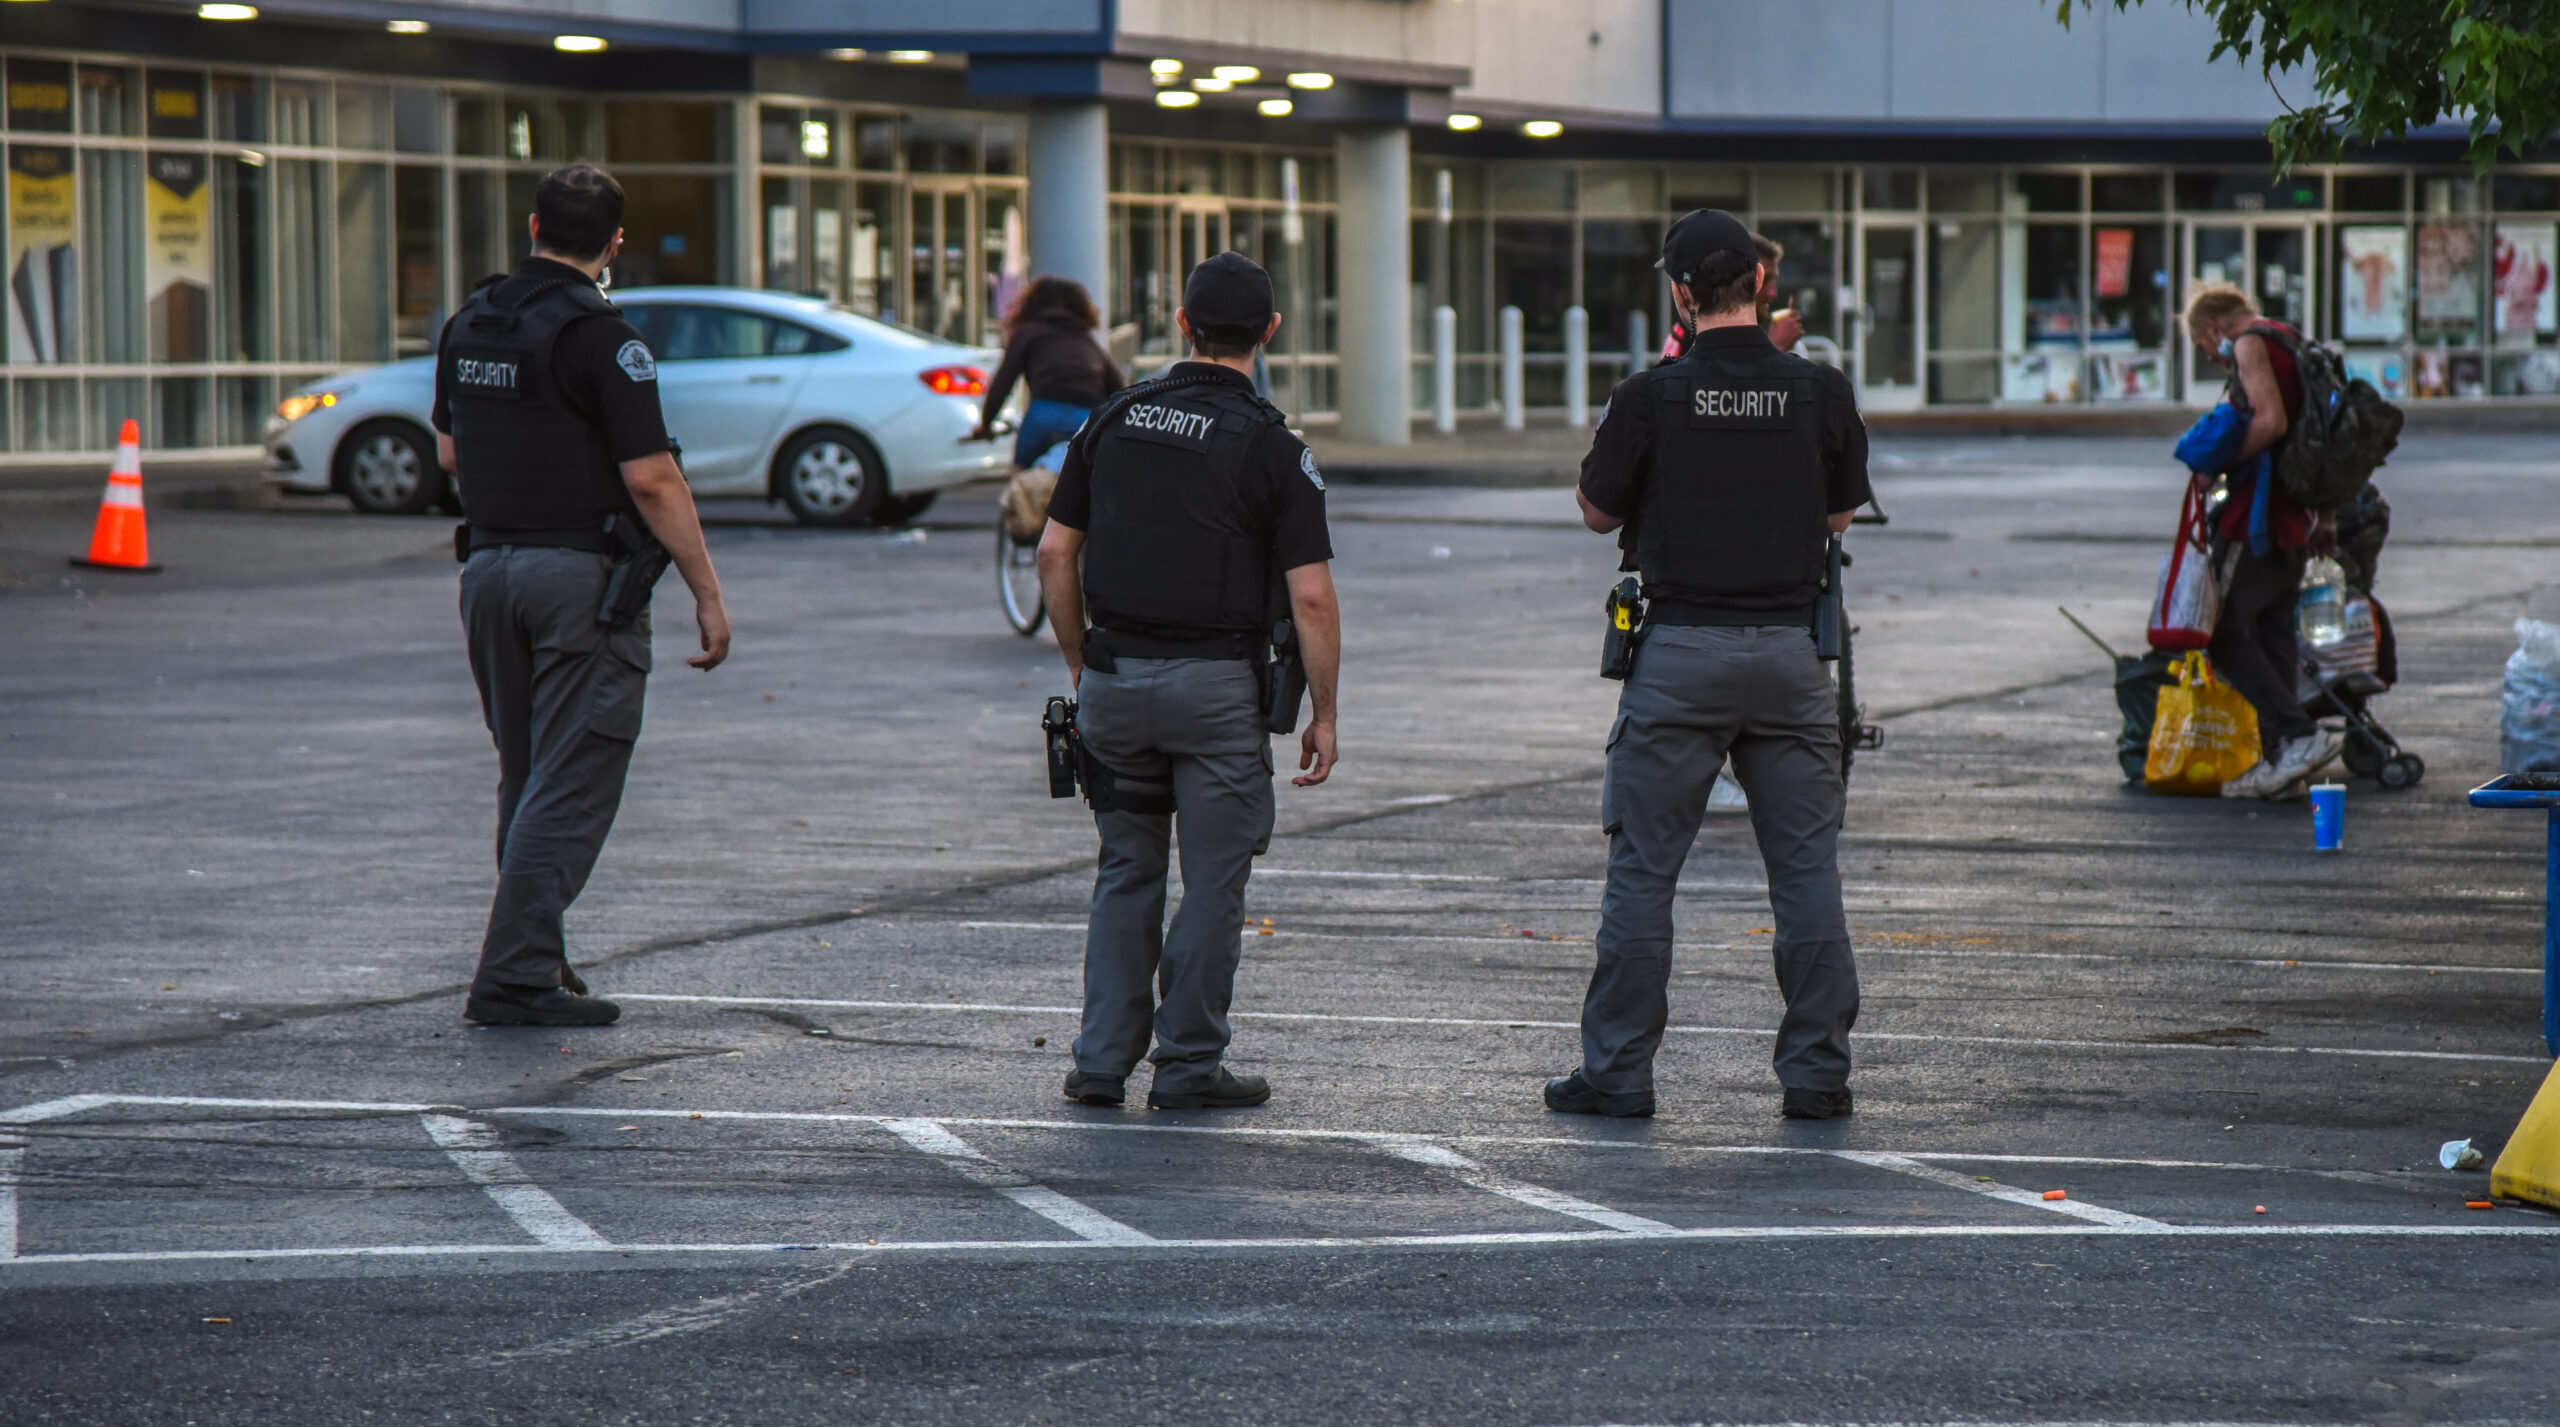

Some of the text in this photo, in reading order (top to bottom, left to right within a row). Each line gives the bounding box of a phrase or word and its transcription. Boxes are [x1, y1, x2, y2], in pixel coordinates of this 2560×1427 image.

[457, 358, 518, 388] SECURITY
[1694, 389, 1788, 417] SECURITY
[1125, 403, 1214, 440] SECURITY
